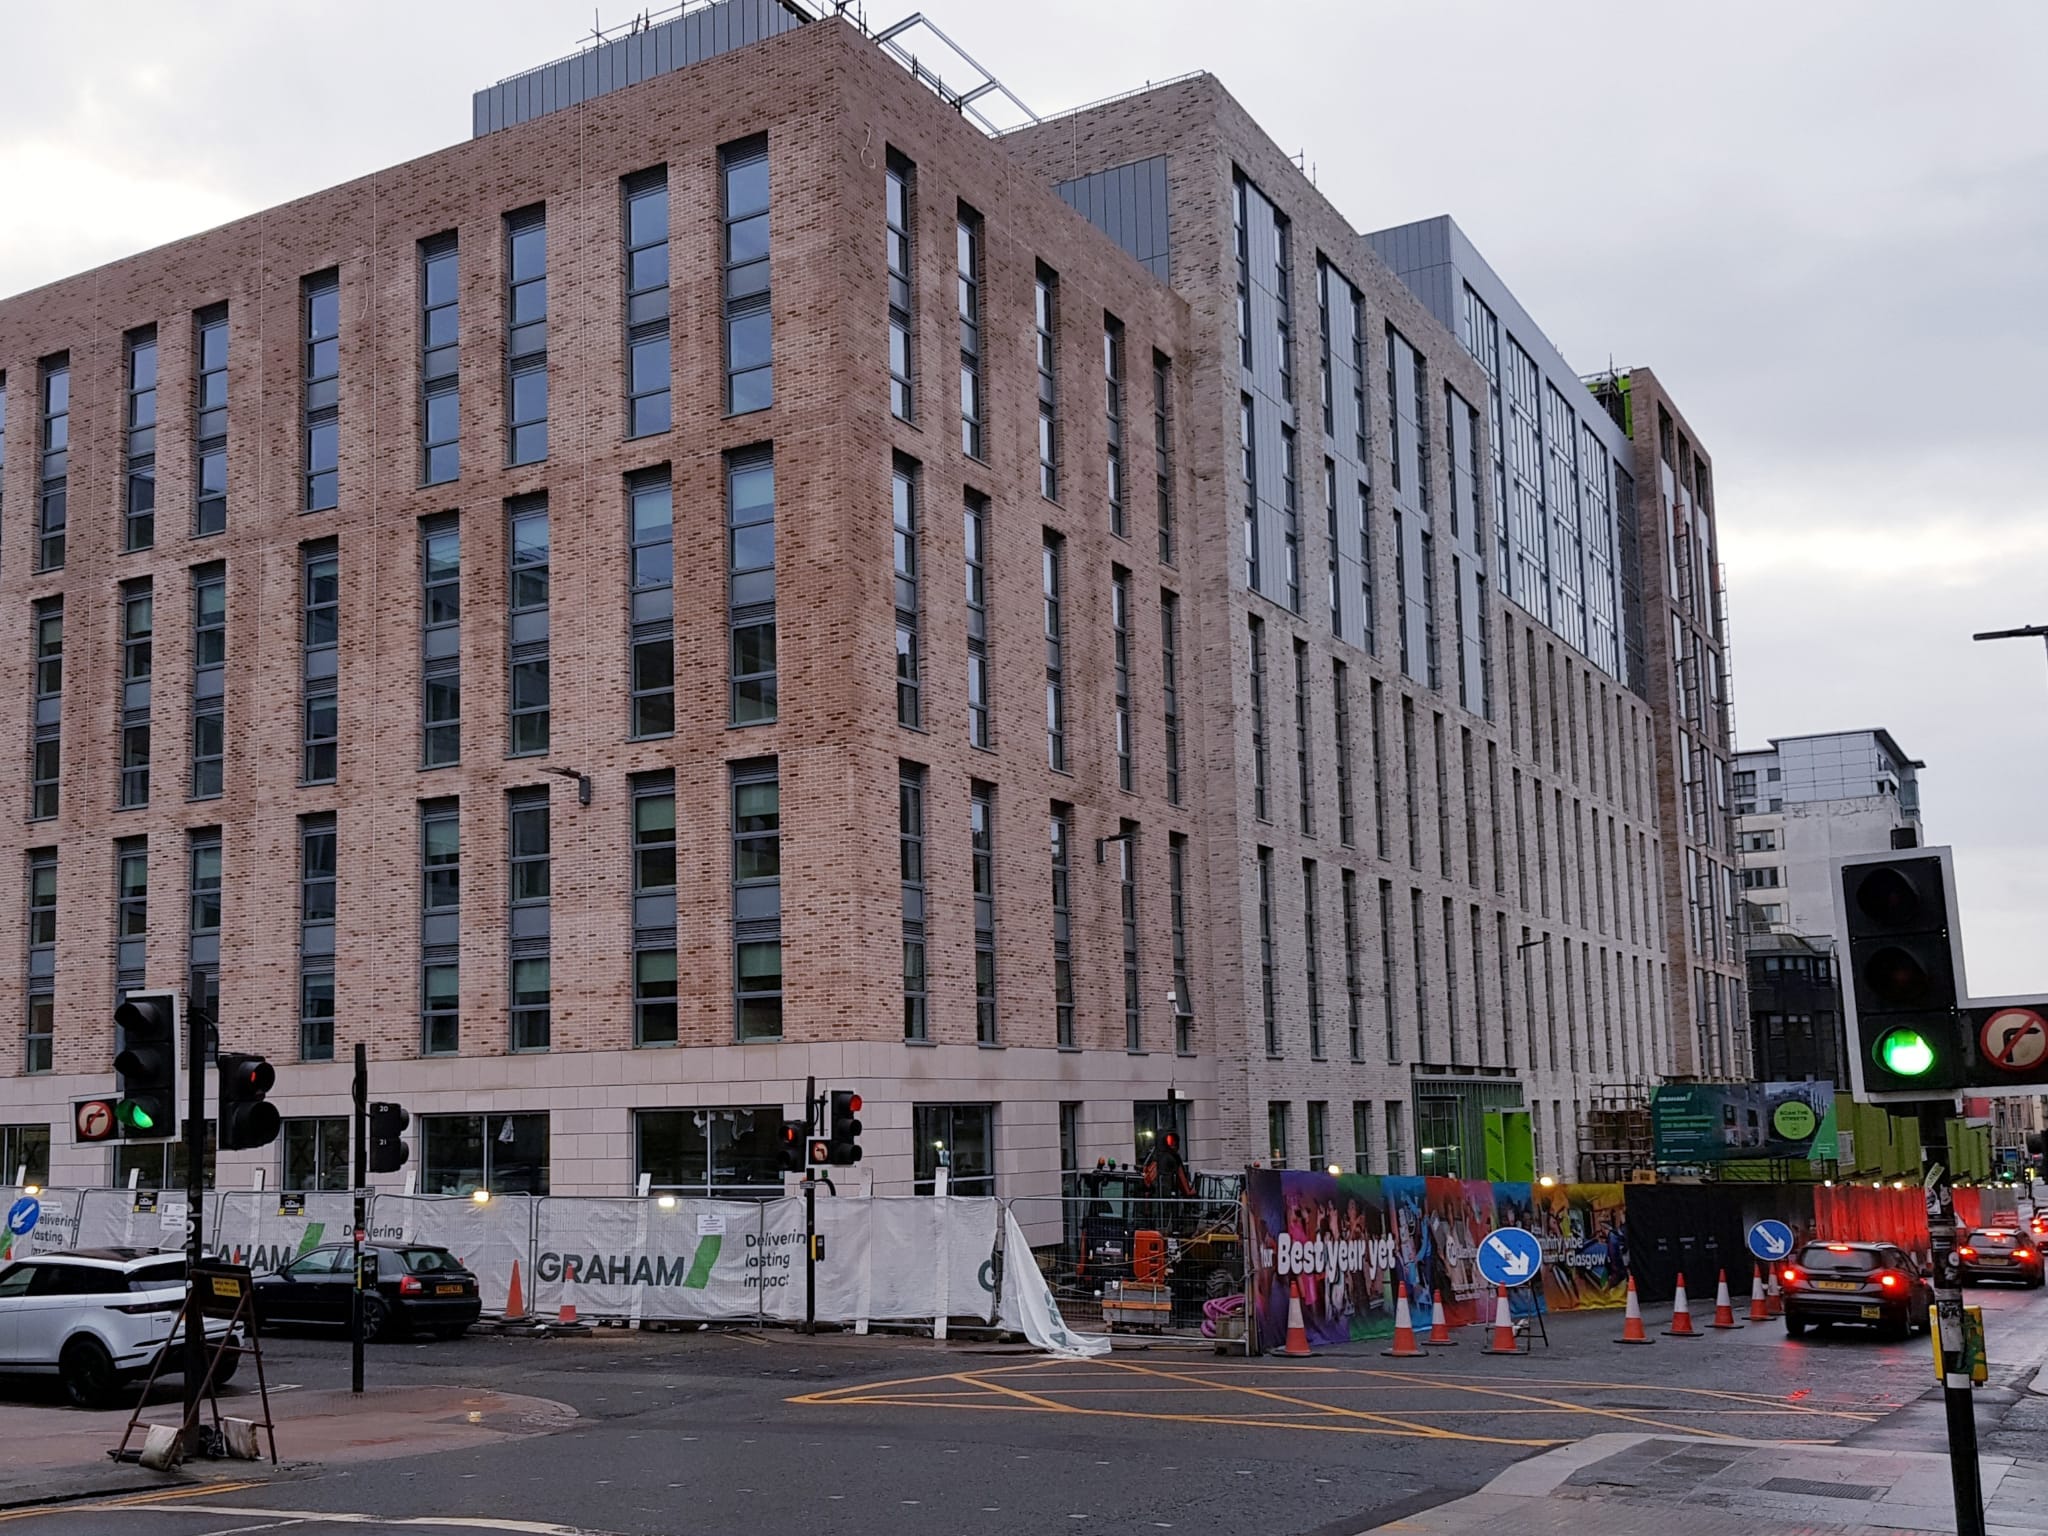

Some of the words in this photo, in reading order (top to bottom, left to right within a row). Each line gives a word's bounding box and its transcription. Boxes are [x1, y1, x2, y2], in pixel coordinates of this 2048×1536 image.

[745, 1228, 806, 1248] Deliverin
[745, 1252, 790, 1269] lasting
[1277, 1232, 1325, 1275] Best
[1327, 1239, 1366, 1283] year
[1369, 1232, 1396, 1280] yet
[1566, 1249, 1606, 1270] Glasgow
[537, 1252, 685, 1287] GRAHAM
